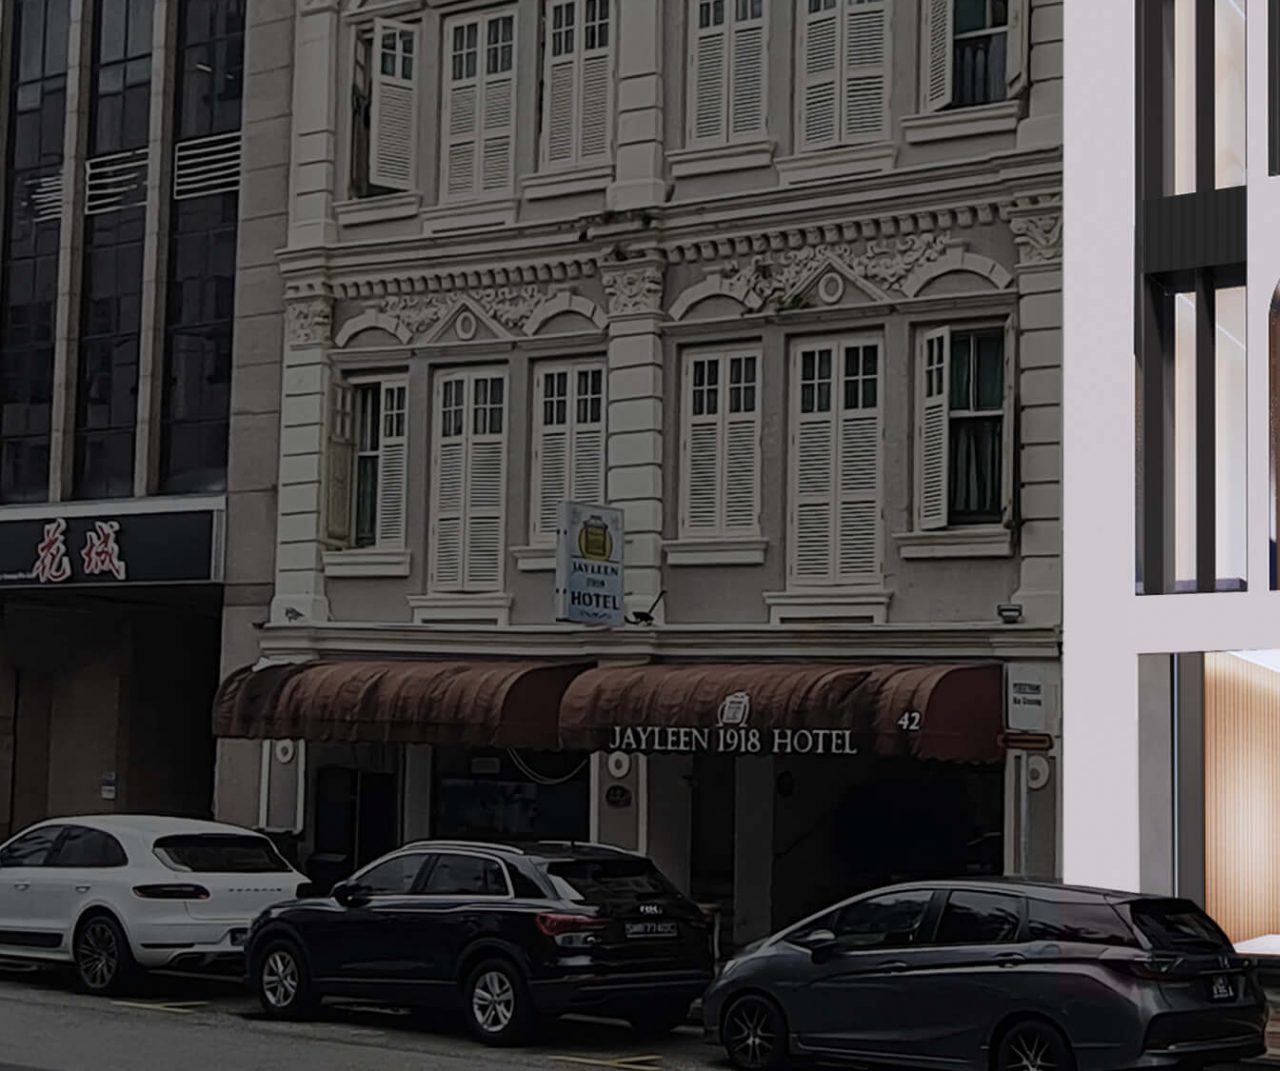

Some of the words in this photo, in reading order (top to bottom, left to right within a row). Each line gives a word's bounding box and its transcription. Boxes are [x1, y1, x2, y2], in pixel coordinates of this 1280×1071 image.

[571, 562, 618, 576] JAYLEEN
[571, 591, 620, 610] HOTEL
[897, 712, 921, 730] 42
[609, 726, 709, 751] JAYLEEN
[716, 729, 761, 752] 1918
[772, 729, 859, 755] HOTEL
